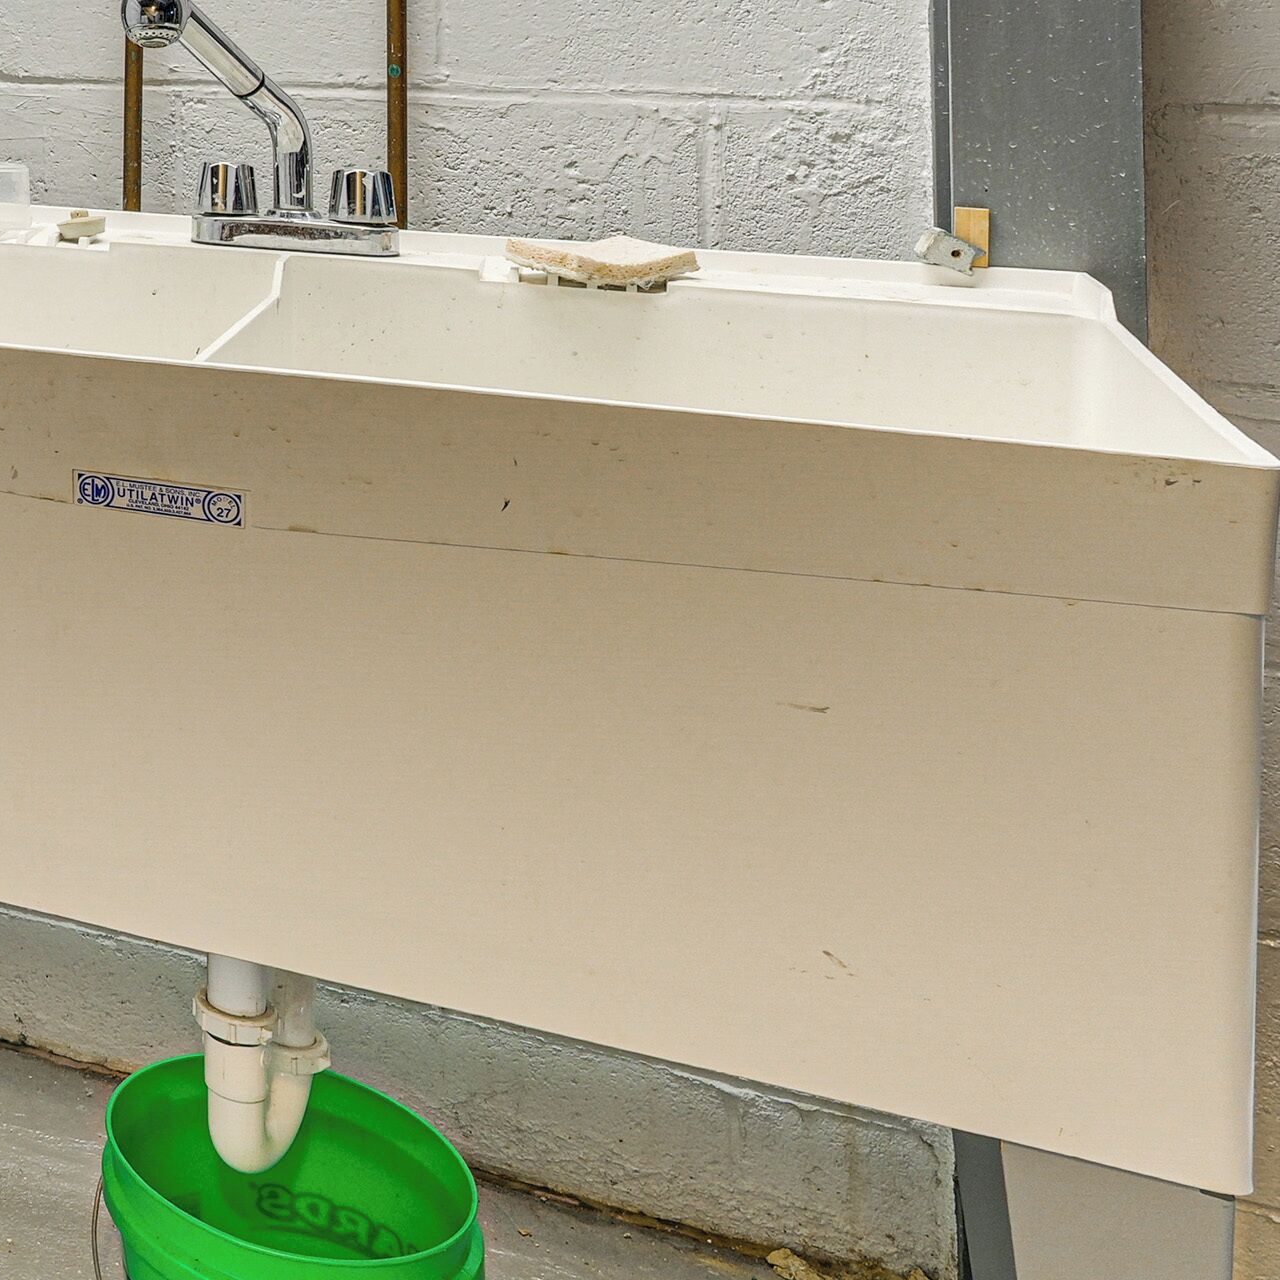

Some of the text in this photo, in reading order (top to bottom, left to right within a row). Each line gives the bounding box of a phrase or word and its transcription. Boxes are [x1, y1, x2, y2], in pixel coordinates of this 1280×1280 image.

[83, 479, 106, 501] ELM
[129, 483, 158, 492] MUSTEE
[217, 507, 232, 518] 27
